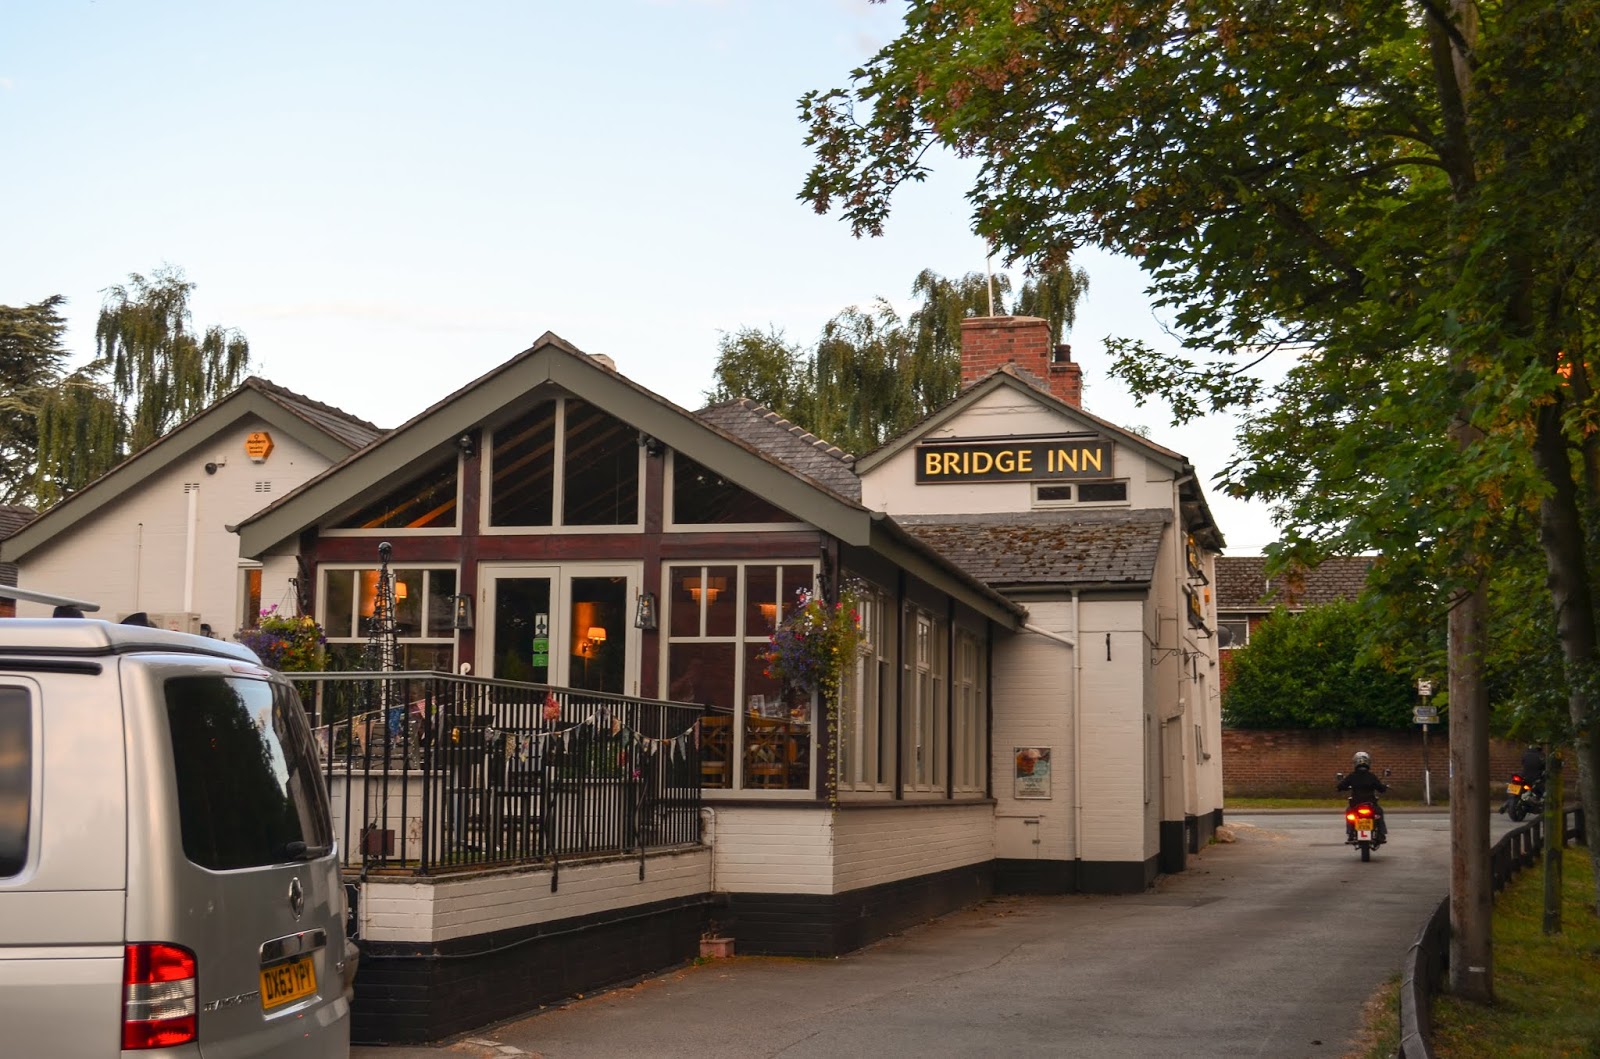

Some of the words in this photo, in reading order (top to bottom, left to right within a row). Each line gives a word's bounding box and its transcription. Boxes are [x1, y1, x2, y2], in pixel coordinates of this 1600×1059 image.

[925, 450, 1033, 475] BRIDGE
[1047, 448, 1102, 473] INN
[1360, 830, 1368, 838] L
[263, 966, 294, 1000] DX63
[294, 961, 313, 991] YPY
